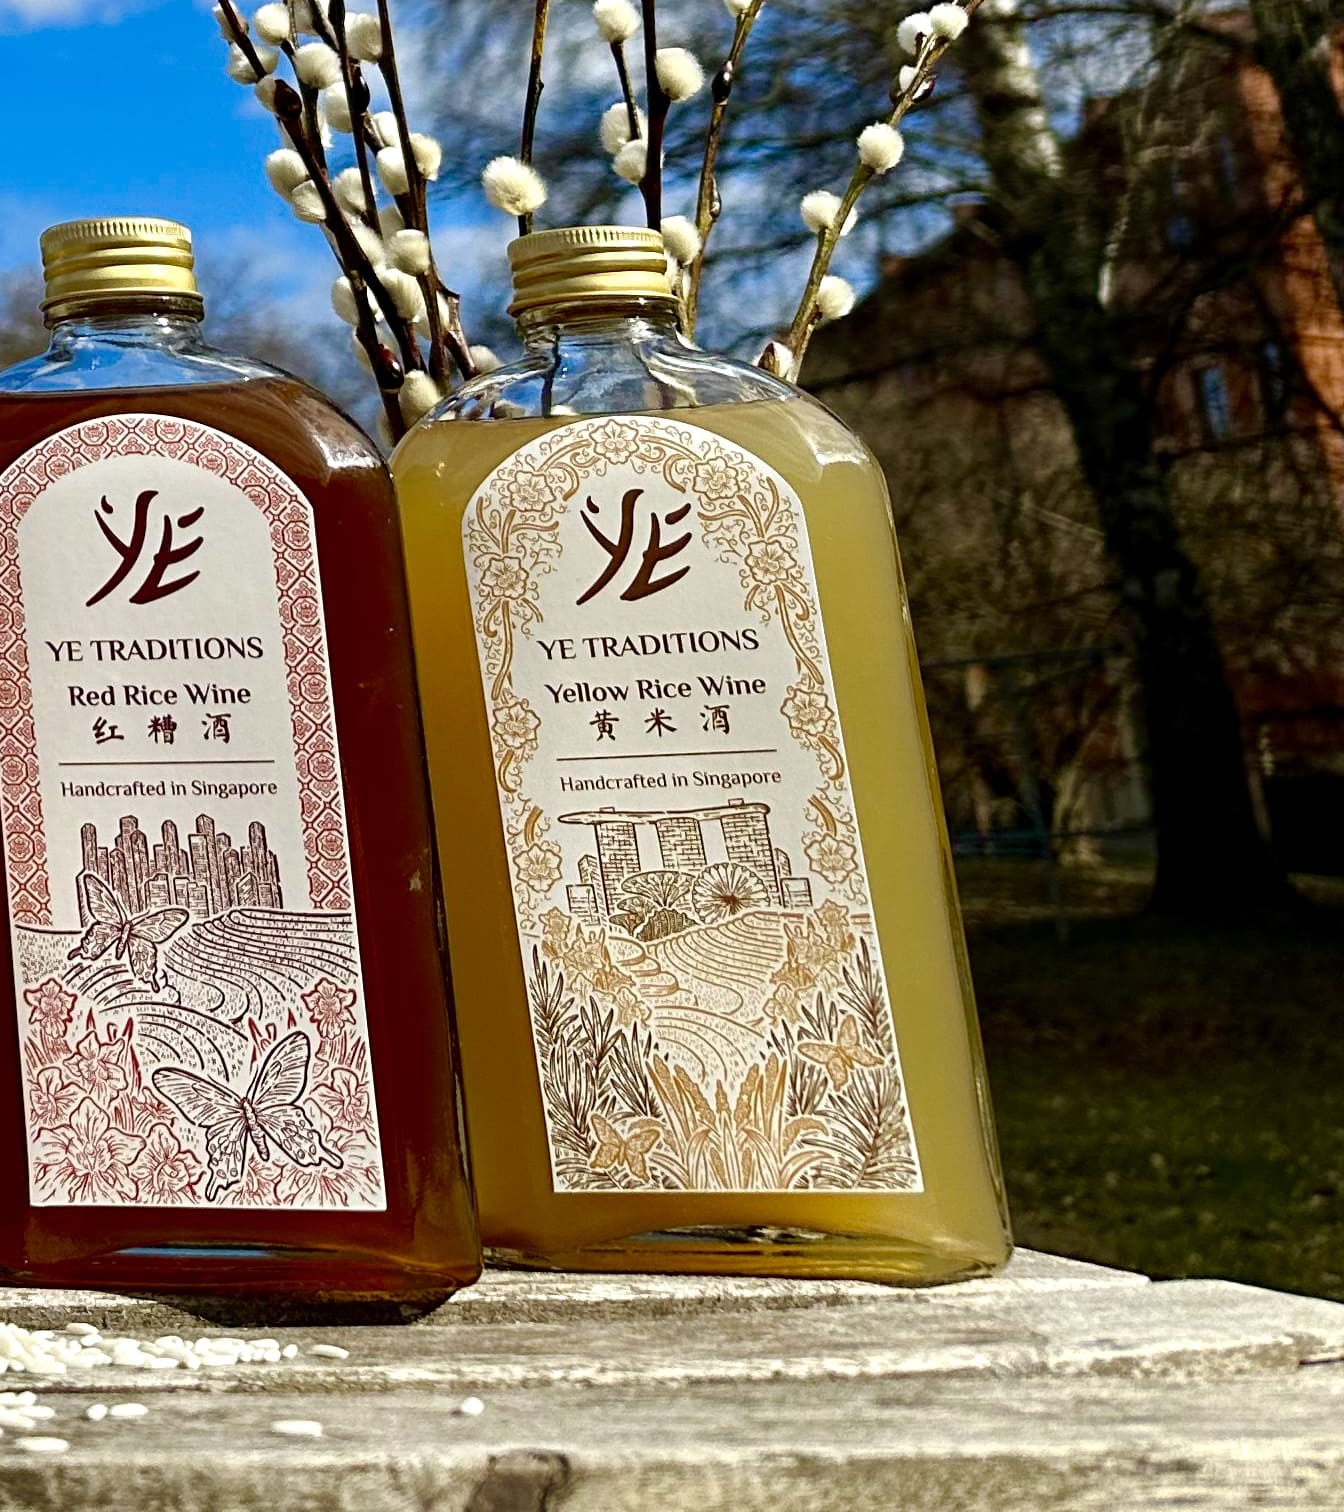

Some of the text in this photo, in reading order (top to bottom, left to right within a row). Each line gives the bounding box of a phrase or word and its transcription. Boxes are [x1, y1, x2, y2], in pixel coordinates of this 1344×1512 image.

[46, 637, 263, 661] YE TRADITIONS
[538, 629, 759, 660] YE TRADITIONS
[69, 684, 250, 706] Red Rice Wine
[545, 676, 765, 703] Yellow Rice Wine
[61, 780, 277, 799] Handcrafted in Singapore
[561, 771, 781, 791] Handcrafted in Singapore
